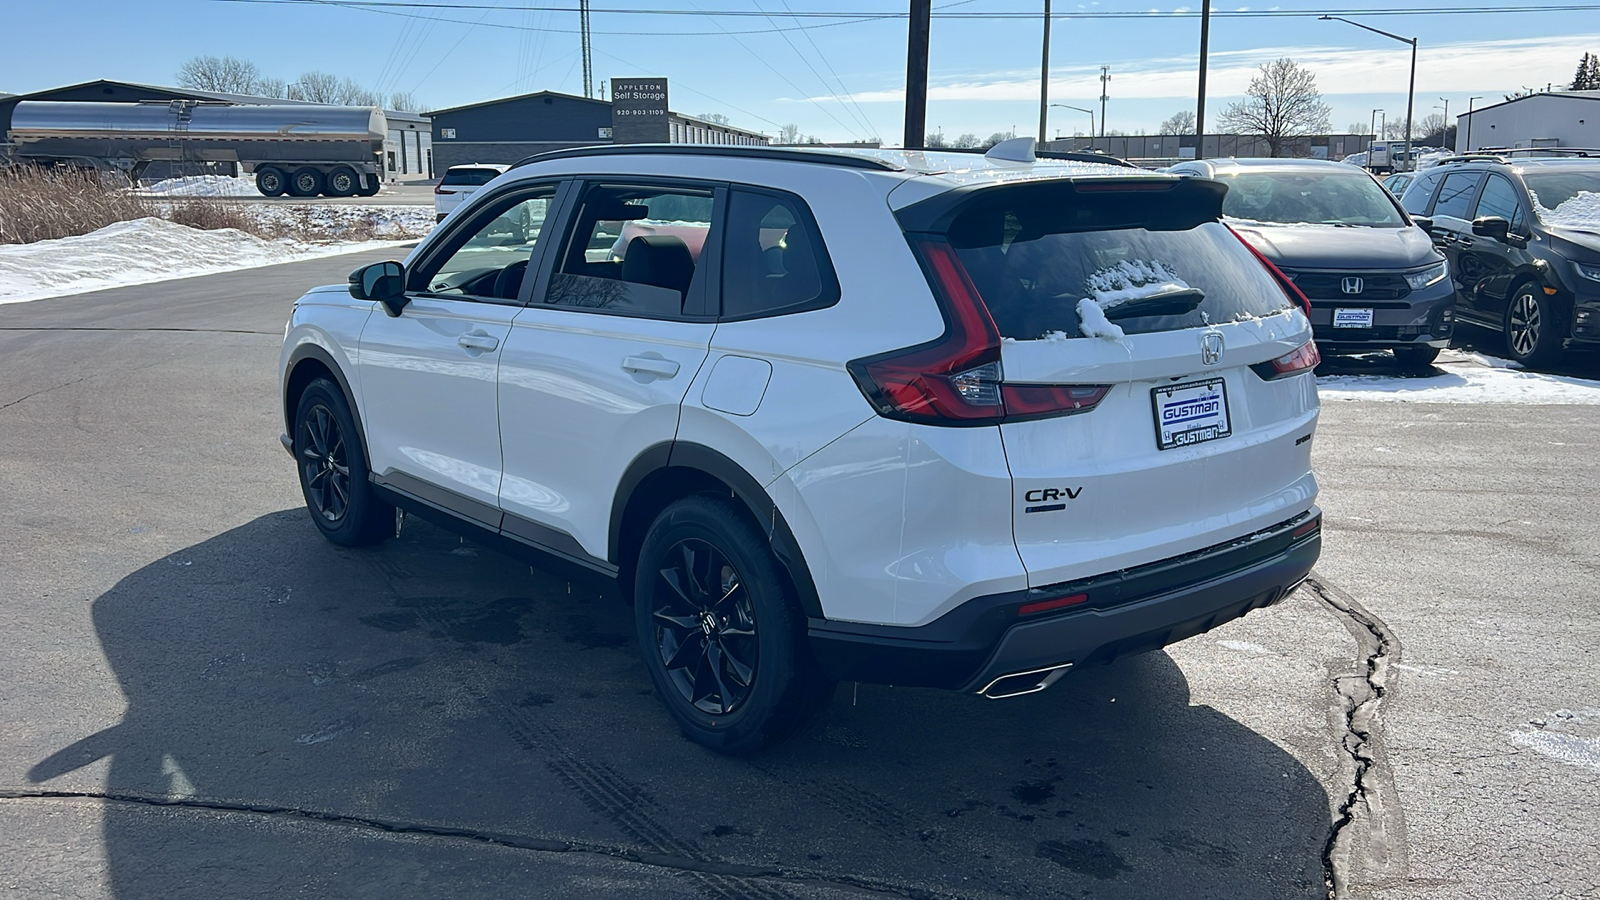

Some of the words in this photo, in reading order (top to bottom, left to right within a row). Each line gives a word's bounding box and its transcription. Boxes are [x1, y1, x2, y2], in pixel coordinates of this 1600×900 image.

[614, 92, 630, 100] Self
[633, 91, 666, 100] Storage
[1157, 379, 1223, 393] www.gustmanhonda.com
[1025, 486, 1083, 502] CR-V
